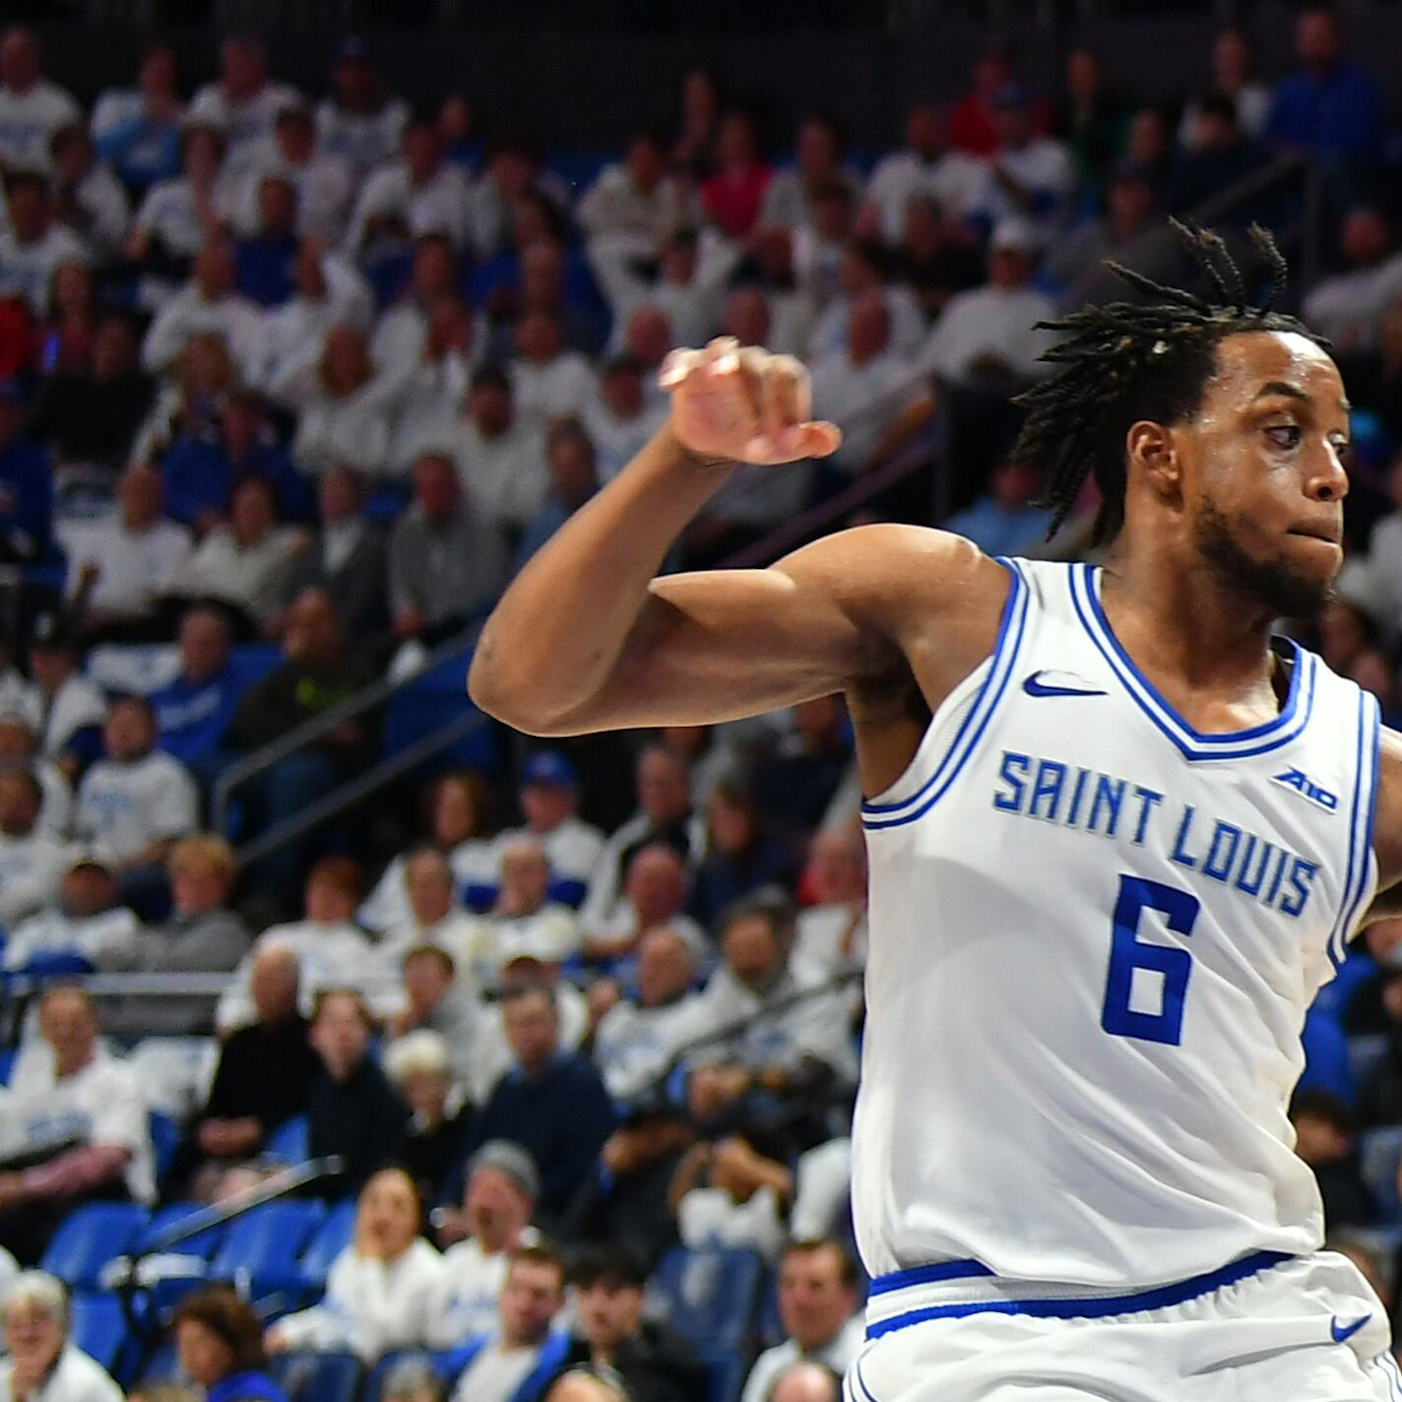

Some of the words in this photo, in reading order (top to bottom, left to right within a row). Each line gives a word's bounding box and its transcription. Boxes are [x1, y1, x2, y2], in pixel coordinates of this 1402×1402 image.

[994, 750, 1164, 846] SAINT
[1169, 803, 1320, 918] LOUIS
[1101, 873, 1200, 1046] 6
